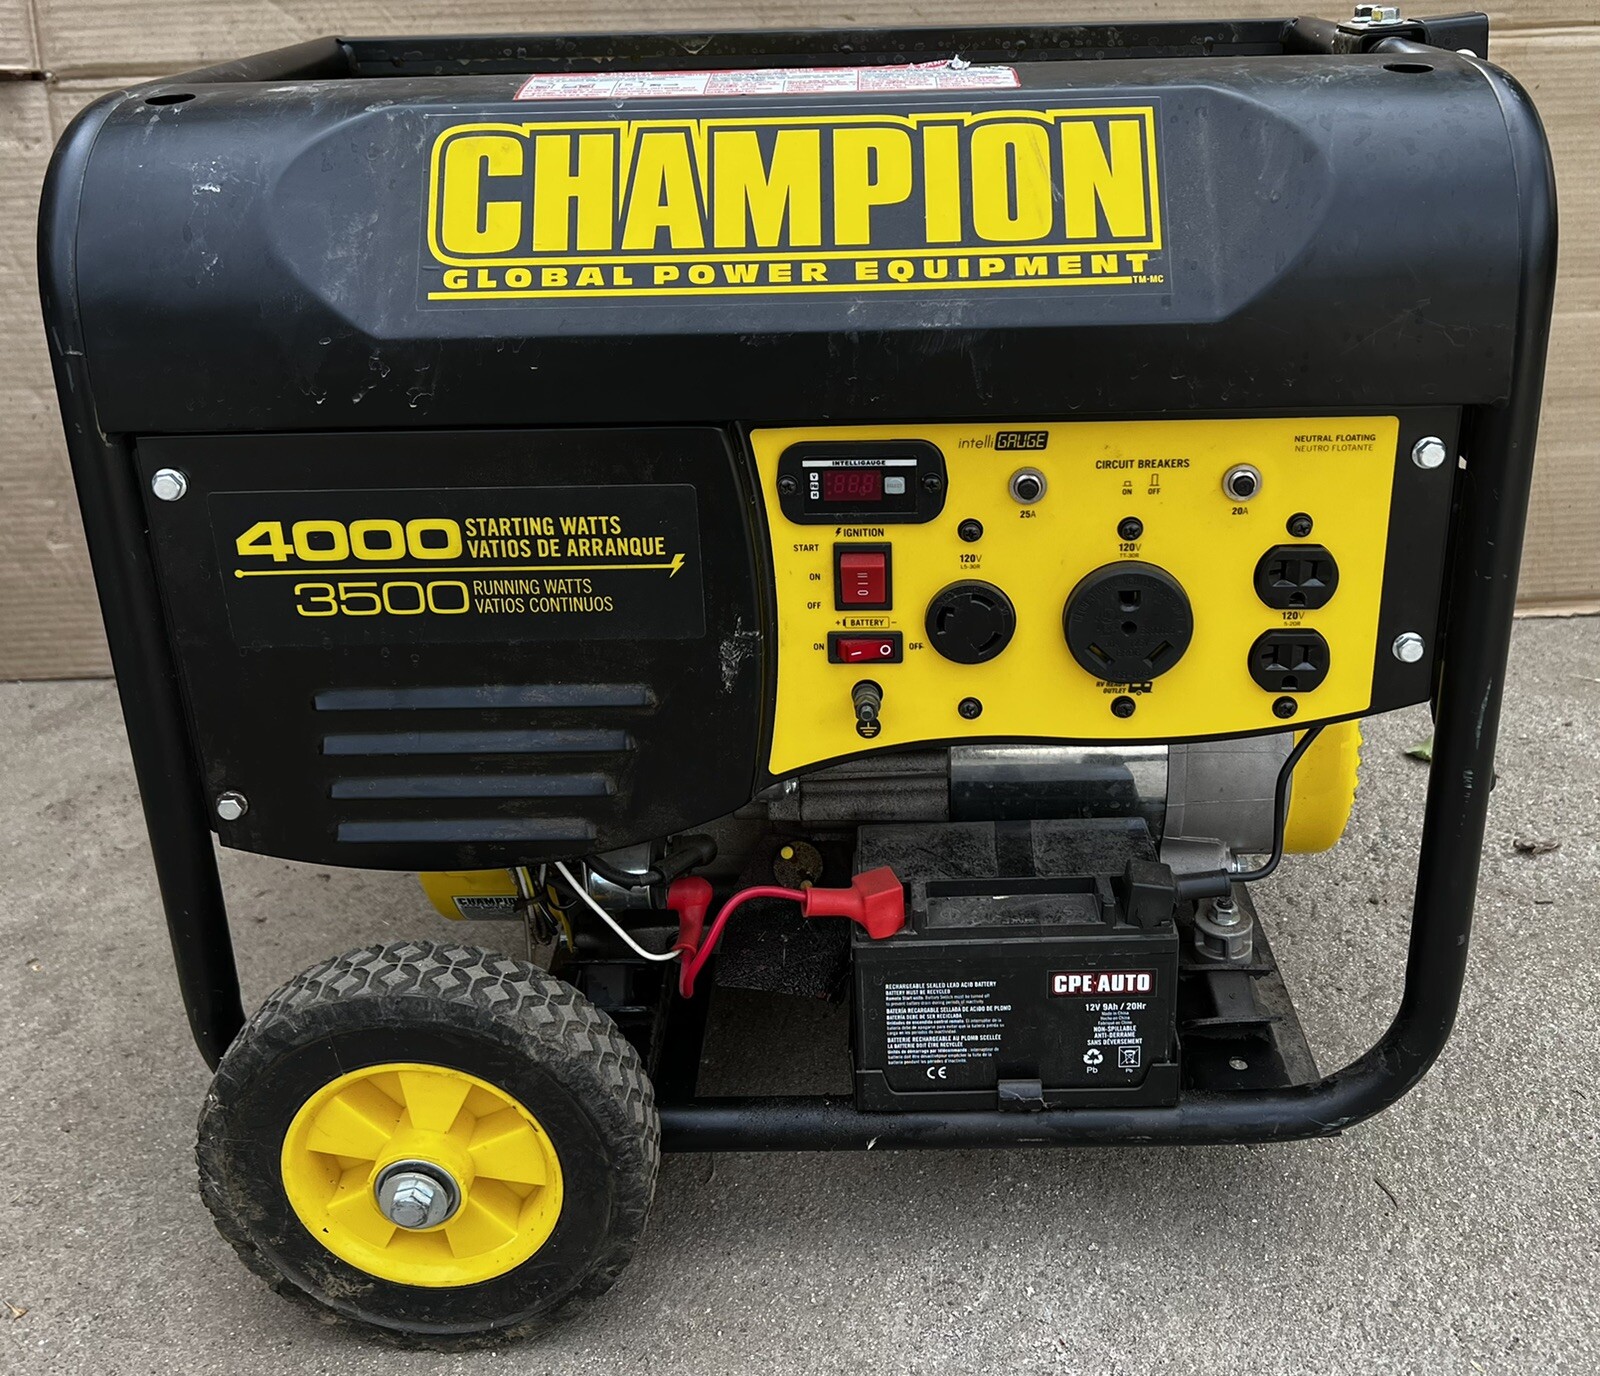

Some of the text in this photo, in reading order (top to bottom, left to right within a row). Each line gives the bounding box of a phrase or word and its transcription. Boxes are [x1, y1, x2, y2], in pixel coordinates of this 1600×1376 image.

[442, 119, 1140, 253] CHAMPION
[442, 252, 1150, 289] GLOBAL POWER EQUIPMENT
[1294, 434, 1376, 443] NEUTRAL FLOATING
[1295, 444, 1374, 453] NEUTRO FLOTANTE
[1095, 458, 1190, 470] CIRCUIT BREAKERS
[1148, 487, 1160, 495] OFF
[1020, 510, 1036, 519] 25A
[1232, 507, 1249, 516] 20A
[465, 515, 622, 537] STARTING WATTS
[843, 528, 885, 537] IGNITION
[236, 518, 463, 561] 4000
[467, 536, 666, 558] VATIOS DE ARRANQUE
[793, 544, 819, 552] START
[1119, 543, 1142, 551] 120V
[959, 554, 982, 563] 120V
[809, 573, 821, 581] ON
[473, 578, 593, 595] RUNNING WATTS
[294, 580, 469, 617] 3500
[475, 596, 614, 613] VATIOS CONTINUOS
[1282, 612, 1305, 620] 120V
[850, 619, 884, 627] BATTERY
[1085, 1003, 1101, 1011] 12V
[1102, 1003, 1118, 1011] 9Ah
[1126, 1002, 1147, 1010] 20Hr
[1102, 1038, 1143, 1046] DÉVERSEMENT
